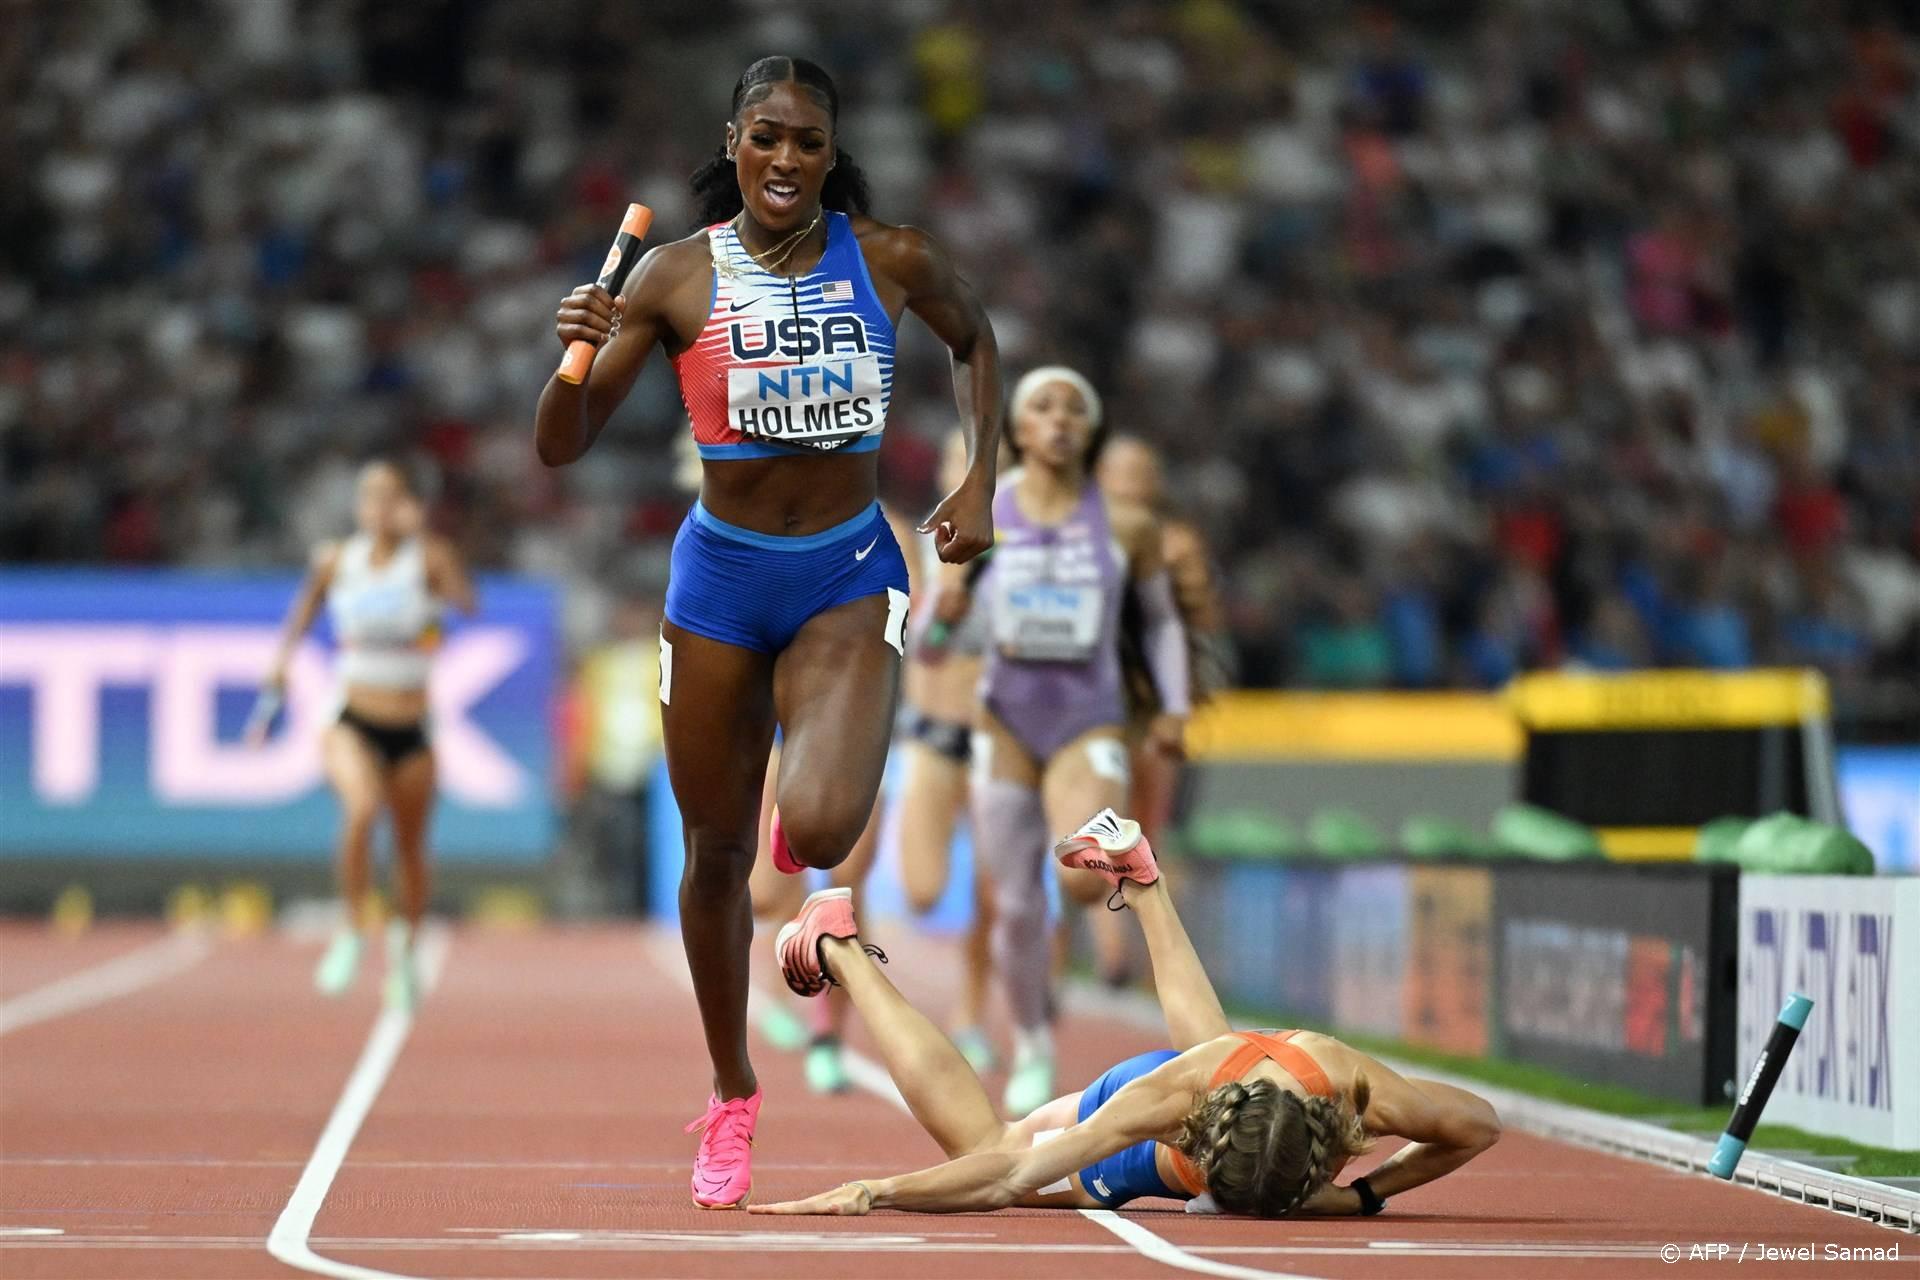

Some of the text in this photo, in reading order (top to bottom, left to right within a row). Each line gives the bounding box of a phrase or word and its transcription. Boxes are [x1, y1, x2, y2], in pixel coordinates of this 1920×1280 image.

[730, 314, 868, 361] USA
[757, 362, 854, 402] NTN
[738, 396, 874, 436] HOLMES
[0, 622, 532, 808] TDK
